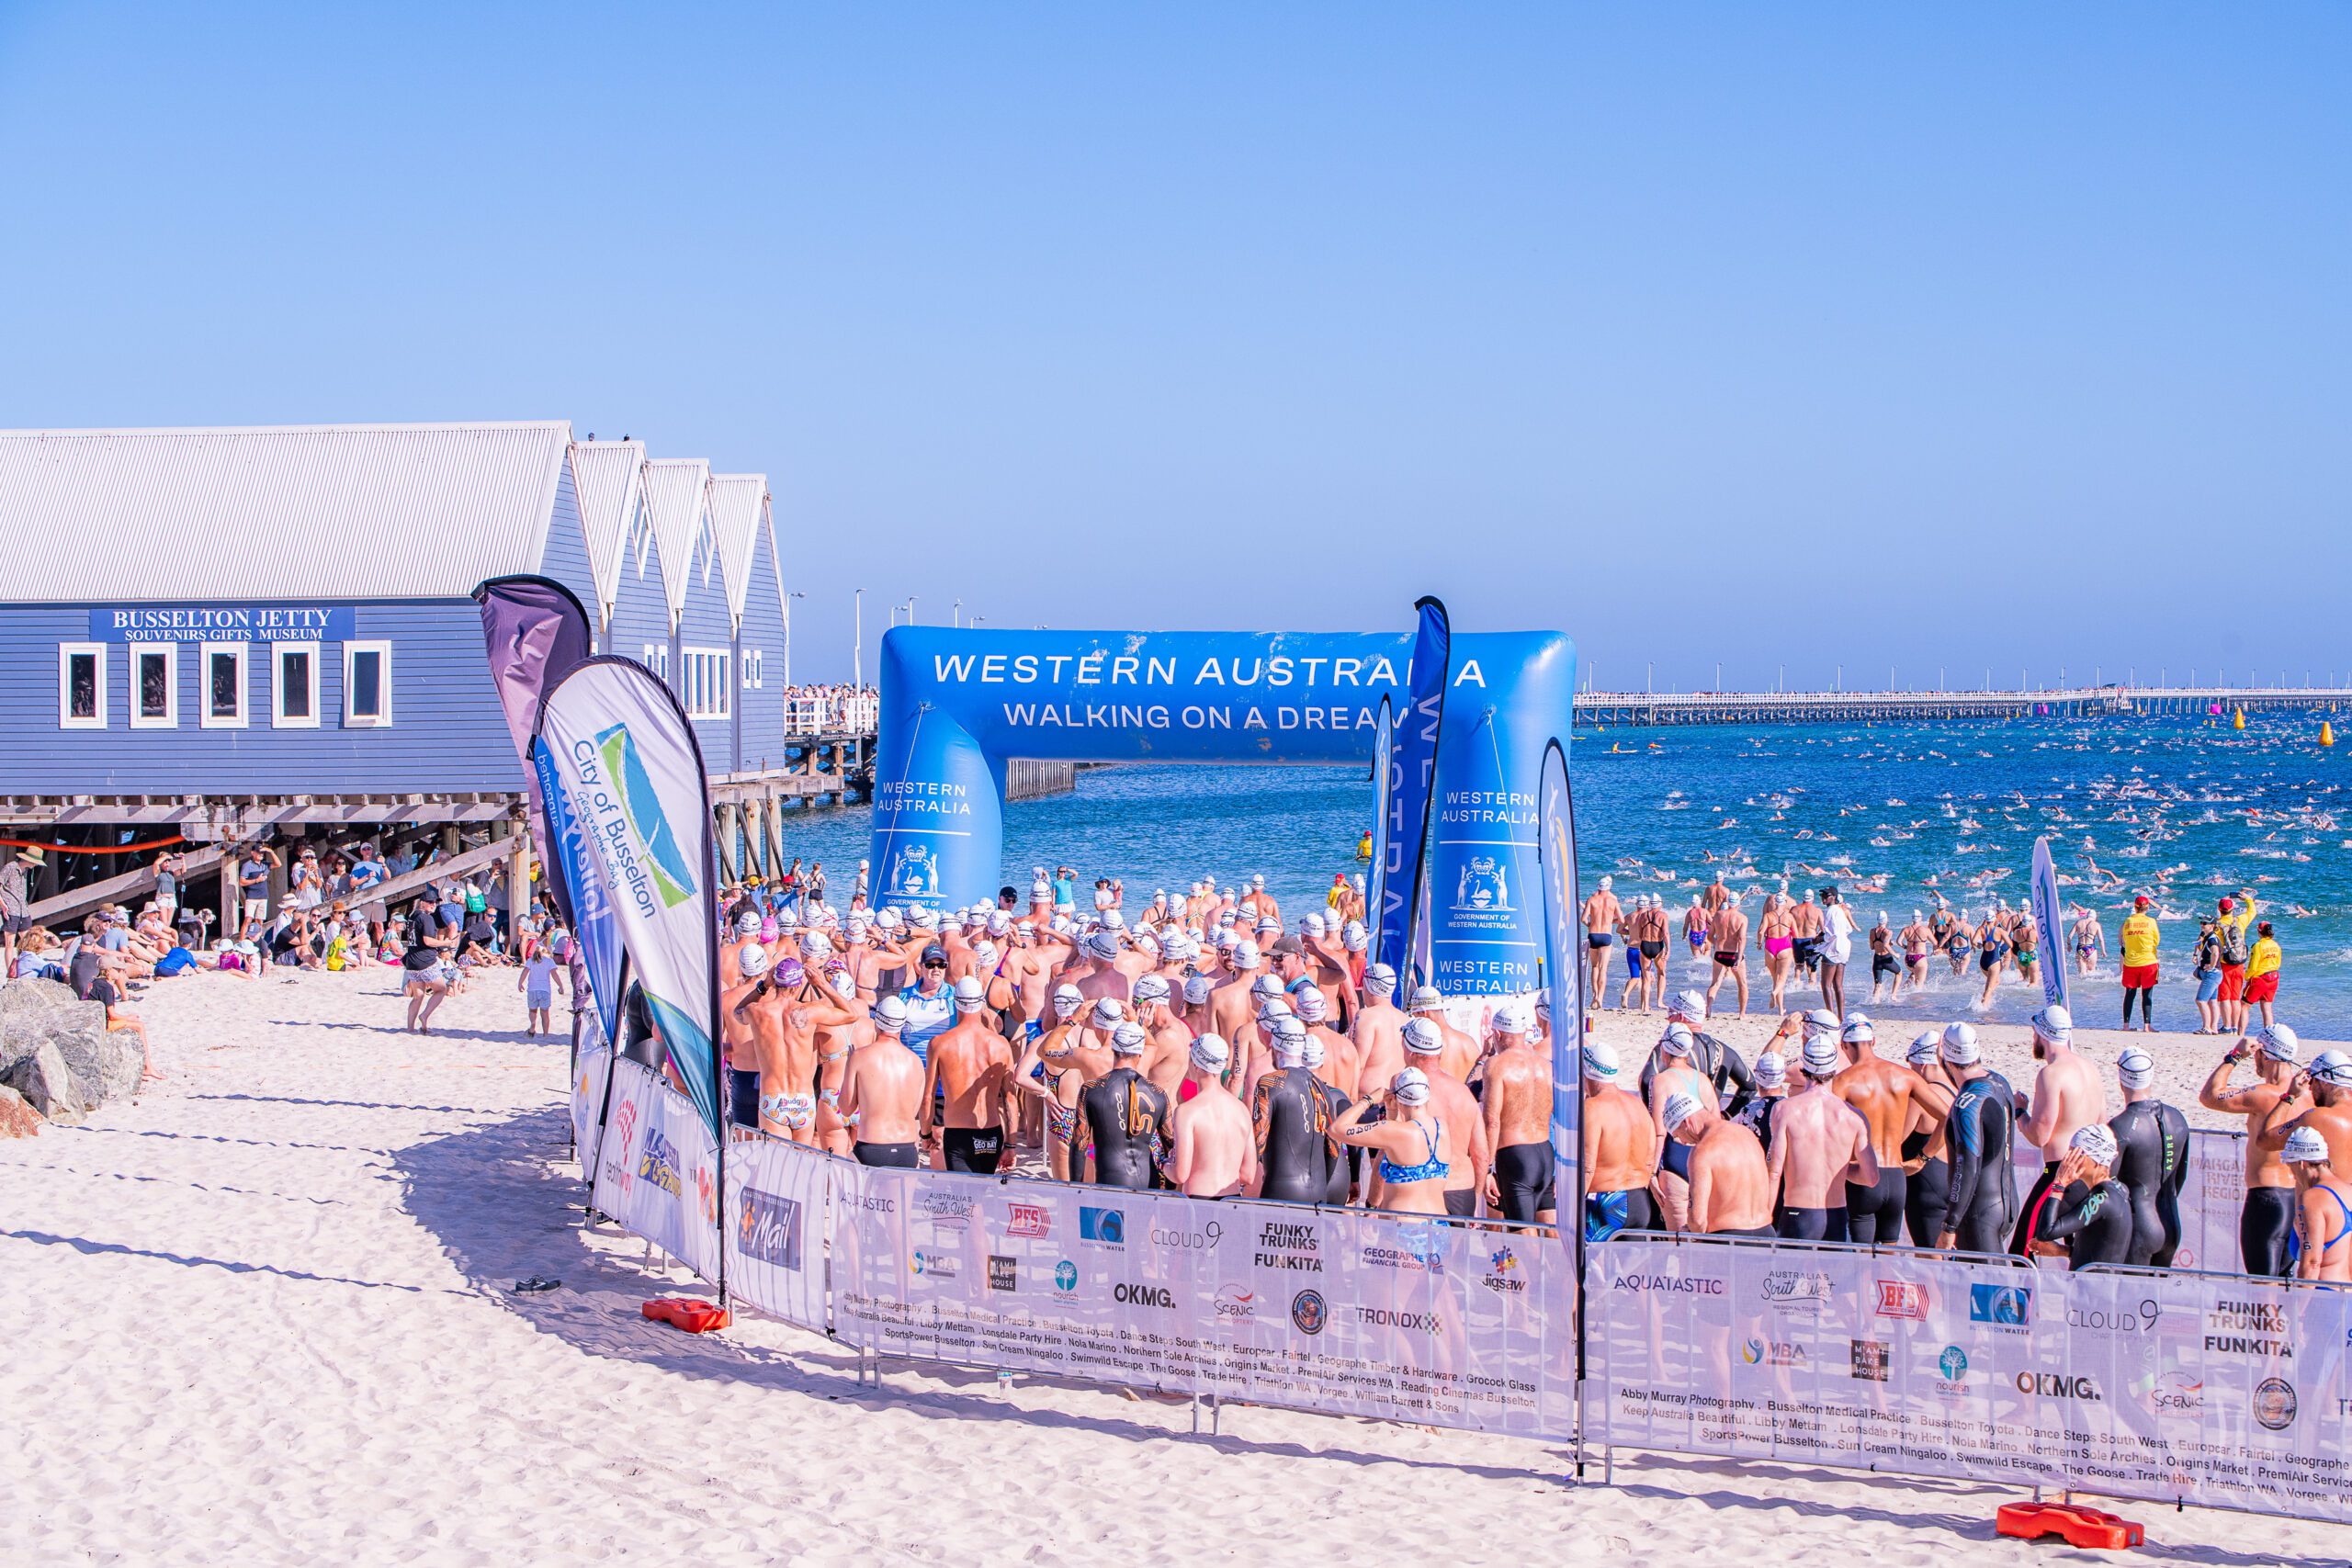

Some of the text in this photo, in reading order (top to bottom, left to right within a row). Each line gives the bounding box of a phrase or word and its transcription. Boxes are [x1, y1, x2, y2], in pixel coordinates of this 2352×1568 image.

[113, 609, 333, 628] BUSSELTON JETTY
[125, 628, 322, 641] SOUVENIRS GIFTS MUSEUM
[933, 654, 1487, 688] WESTERN AUSTRAA
[1003, 703, 1170, 728] WALKING
[1182, 705, 1231, 729] ON
[1243, 706, 1269, 730] A
[883, 782, 966, 797] WESTERN
[877, 799, 971, 815] AUSTRALIA
[1446, 792, 1534, 807] WESTERN
[1441, 809, 1540, 825] AUSTRALIA
[573, 739, 656, 919] City of Busselton
[576, 791, 620, 890] Geographe Bay
[887, 898, 930, 907] GOVERNMENT
[1453, 913, 1499, 921] GOVERNMENT
[1440, 960, 1528, 976] WESTERN
[1435, 979, 1533, 994] AUSTRALIA
[2165, 1134, 2174, 1171] AZURE
[2189, 1156, 2245, 1173] MARGA
[929, 1192, 973, 1202] AUSTRALIA'S
[922, 1199, 976, 1218] South West
[1014, 1207, 1039, 1227] BFS
[752, 1202, 796, 1260] Mail
[1151, 1221, 1224, 1249] CLOUD 9
[1265, 1222, 1314, 1239] FUNKY
[2298, 1213, 2312, 1250] 1776
[1259, 1234, 1317, 1251] TRUNKS
[1254, 1253, 1323, 1273] FUNKITA
[1362, 1257, 1425, 1270] FINANCIAL GROUP
[1363, 1247, 1424, 1263] GEOGRAPHE
[990, 1279, 1014, 1288] HOUSE
[1613, 1274, 1723, 1294] AQUATASTIC
[1769, 1270, 1829, 1280] AUSTRALIA'S
[1053, 1292, 1080, 1302] nourish
[1114, 1282, 1177, 1309] OKMG.
[1760, 1278, 1799, 1301] South
[1884, 1285, 1916, 1309] BFS
[1356, 1307, 1423, 1330] TRONOX
[2066, 1299, 2163, 1332] CLOUD 9
[2218, 1301, 2283, 1318] FUNKY
[2005, 1327, 2030, 1336] WATER
[2209, 1314, 2286, 1333] TRUNKS
[2204, 1336, 2293, 1358] FUNKITA
[885, 1327, 1460, 1414] SportsPower Busselton Sun Cream Ningaloo Swimwild Escape The Goose Trade Hire Vorgee William Barrett Sons
[944, 1322, 1537, 1408] Mettam Lonsdale Party Hire Nola Marino Northern Sole Origins Market PremiAir Services Reading Cinemas Busselton
[1120, 1331, 1536, 1393] Dance Steps South West Europcar Hardware Grocock Glass
[1855, 1357, 1880, 1366] BAKE
[1856, 1368, 1884, 1377] HOUSE
[1936, 1381, 1970, 1393] nourish
[2017, 1371, 2101, 1401] OKMG.
[1621, 1388, 2350, 1472] Abby Murray Photography Busselton Medical Practice Steps West Geographe
[1650, 1407, 2310, 1483] Australia Beautiful Origins Market PremiAir
[1702, 1427, 2329, 1503] SportsPower Busselton Sun Cream Ningaloo Swimwild Escape The Goose Vorgee
